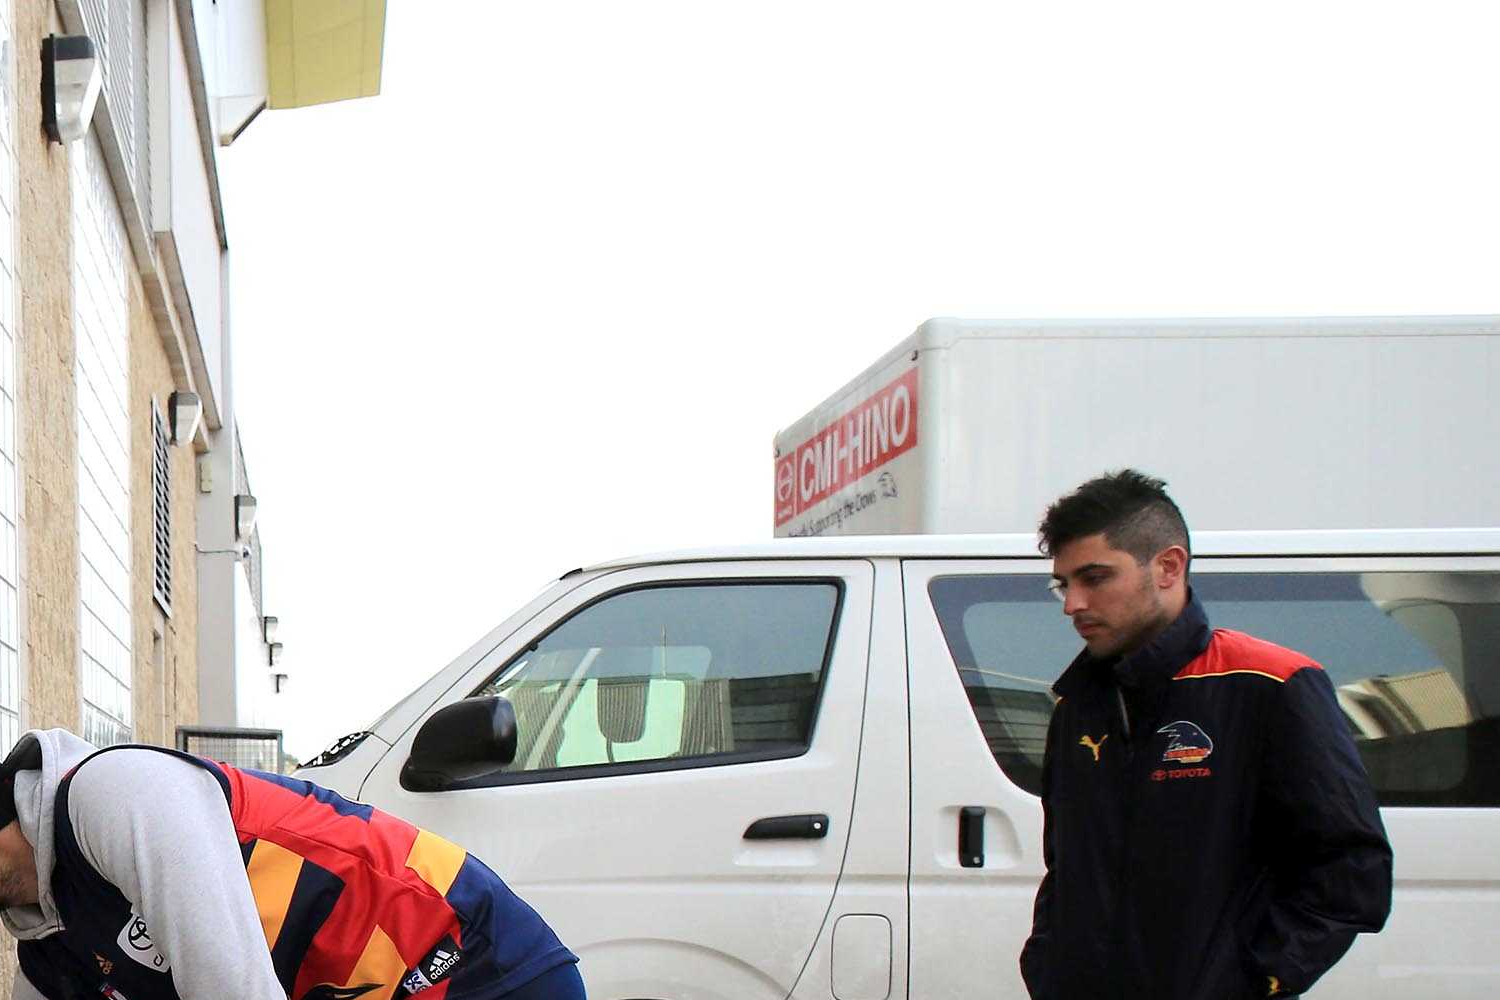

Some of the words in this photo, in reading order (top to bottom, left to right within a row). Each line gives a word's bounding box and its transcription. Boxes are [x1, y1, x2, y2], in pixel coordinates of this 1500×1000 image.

[801, 385, 910, 502] CMI-HINO
[1168, 768, 1211, 778] TOYOTA
[430, 952, 460, 979] adidas
